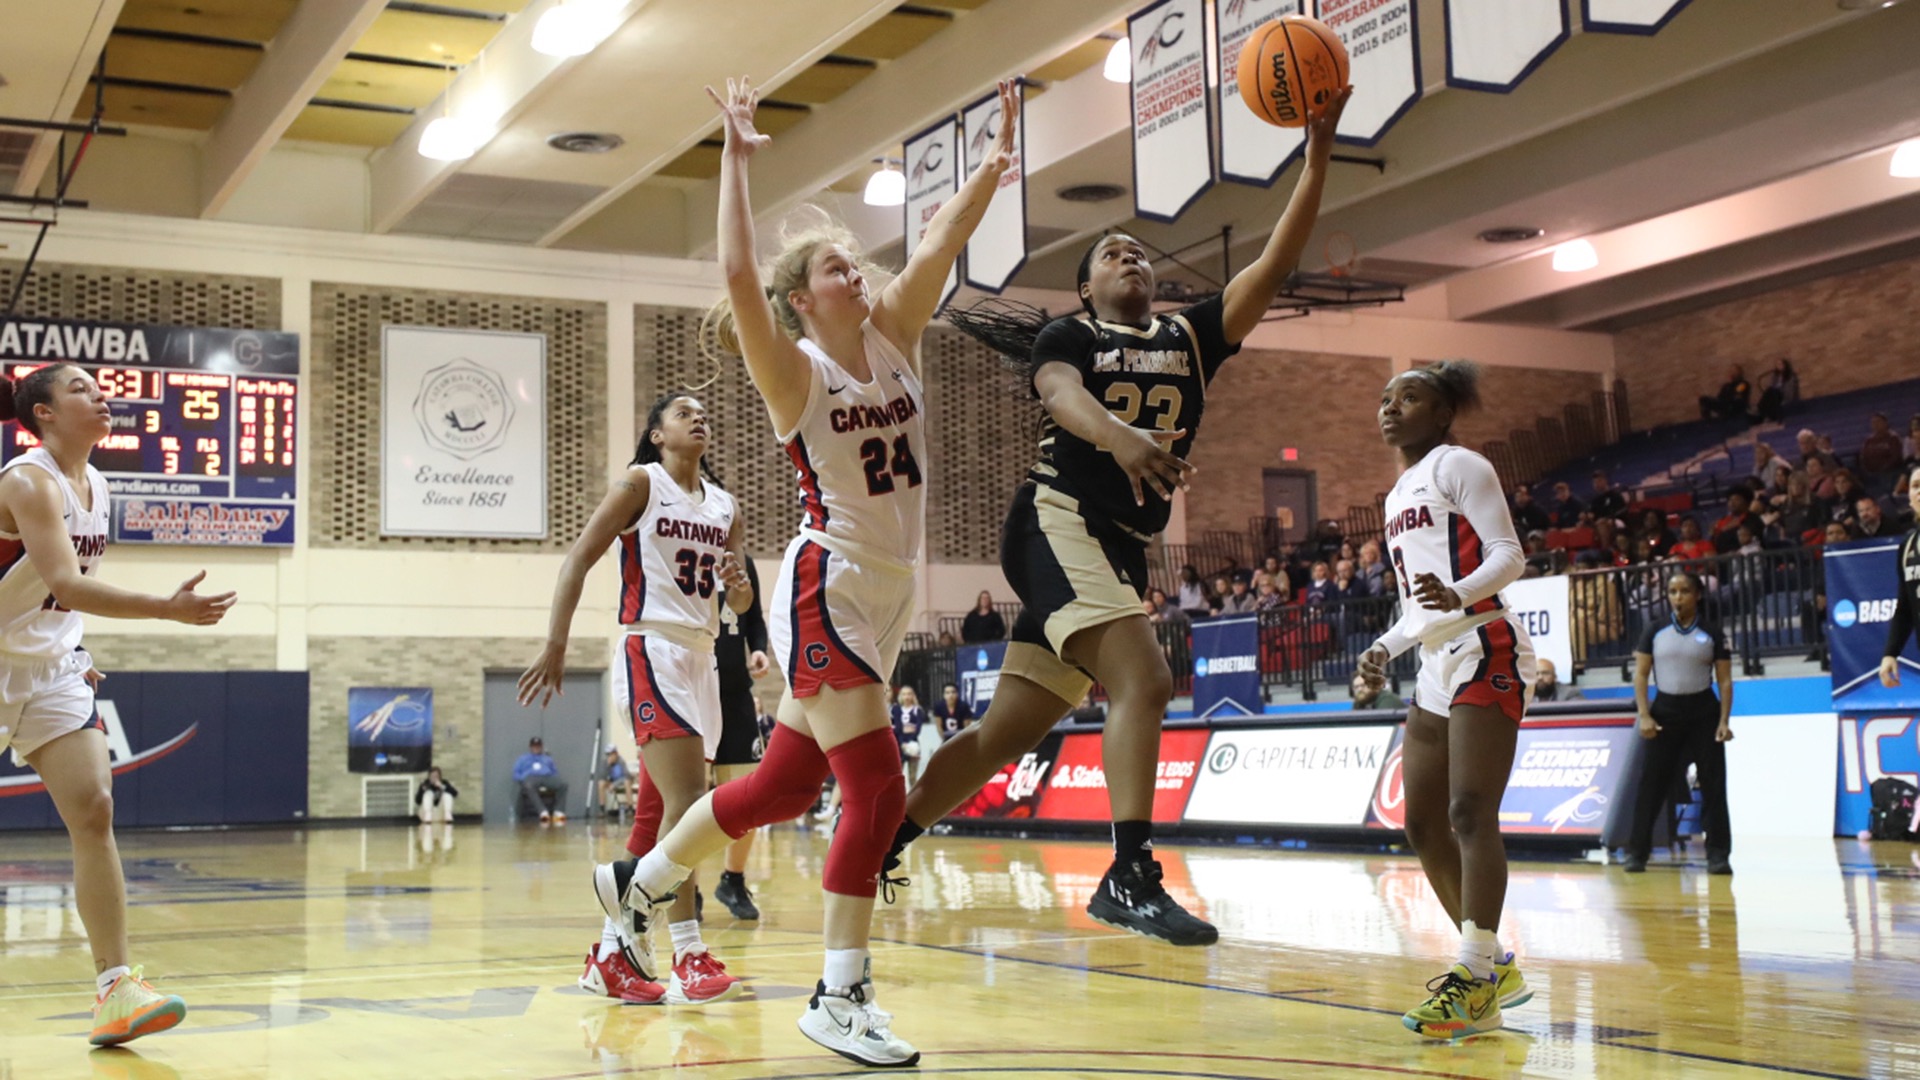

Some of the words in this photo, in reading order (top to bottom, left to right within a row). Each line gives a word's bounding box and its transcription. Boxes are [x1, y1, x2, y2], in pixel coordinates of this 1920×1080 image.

[1381, 3, 1407, 25] 2004
[1270, 51, 1298, 122] Wilson
[1137, 83, 1204, 126] CHAMPIONS
[0, 322, 150, 363] ATAWBA
[183, 389, 220, 420] 25
[830, 392, 918, 434] CATAWBA
[145, 410, 160, 433] 3
[164, 452, 179, 475] 3
[205, 453, 221, 476] 2
[415, 465, 515, 486] Excellence
[860, 432, 922, 496] 24
[109, 480, 200, 495] aindians.com
[423, 491, 464, 506] Since
[469, 492, 507, 507] 1851
[125, 501, 289, 531] Salisbury
[674, 547, 717, 600] 33
[1517, 610, 1550, 636] TED
[805, 642, 830, 670] C
[1208, 655, 1257, 675] BASKETBALL
[638, 701, 656, 724] C
[1242, 746, 1318, 770] CAPITAL
[1323, 744, 1382, 769] BANK
[1520, 748, 1611, 768] CATAWBA
